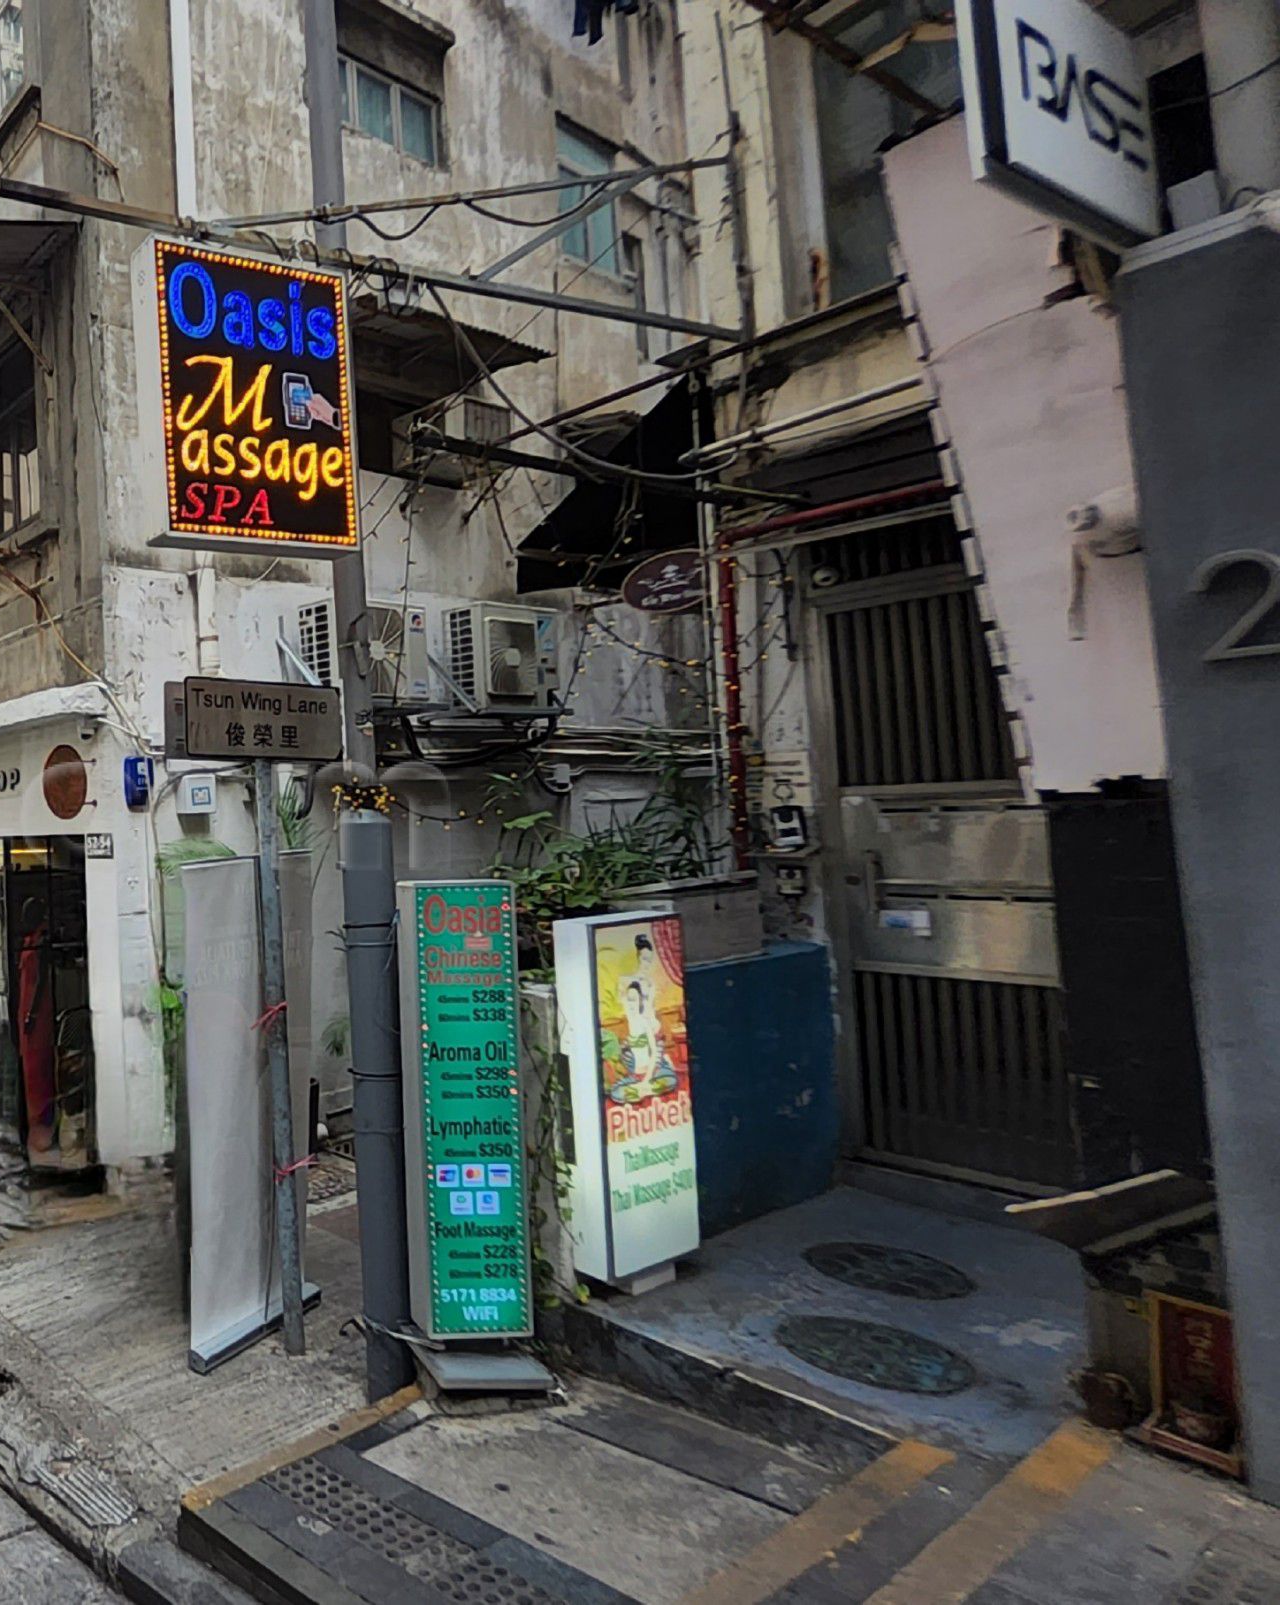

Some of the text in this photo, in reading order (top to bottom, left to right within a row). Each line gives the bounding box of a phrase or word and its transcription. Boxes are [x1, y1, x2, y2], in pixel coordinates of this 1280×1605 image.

[168, 261, 336, 360] Oasis
[181, 481, 274, 525] SPA
[191, 687, 328, 715] Tsun Wing Lane
[225, 722, 299, 748] 俊榮里
[424, 946, 502, 969] Chinese
[472, 989, 506, 1003] $288
[473, 1008, 506, 1021] $338
[429, 1041, 508, 1062] Aroma Oil
[476, 1086, 509, 1099] $350
[608, 1090, 692, 1142] Phuket
[430, 1116, 512, 1141] Lymphatic
[479, 1142, 513, 1157] $350
[435, 1221, 517, 1241] Foot Massage
[483, 1244, 517, 1259] $228
[484, 1263, 518, 1279] $278
[440, 1288, 476, 1303] 5171
